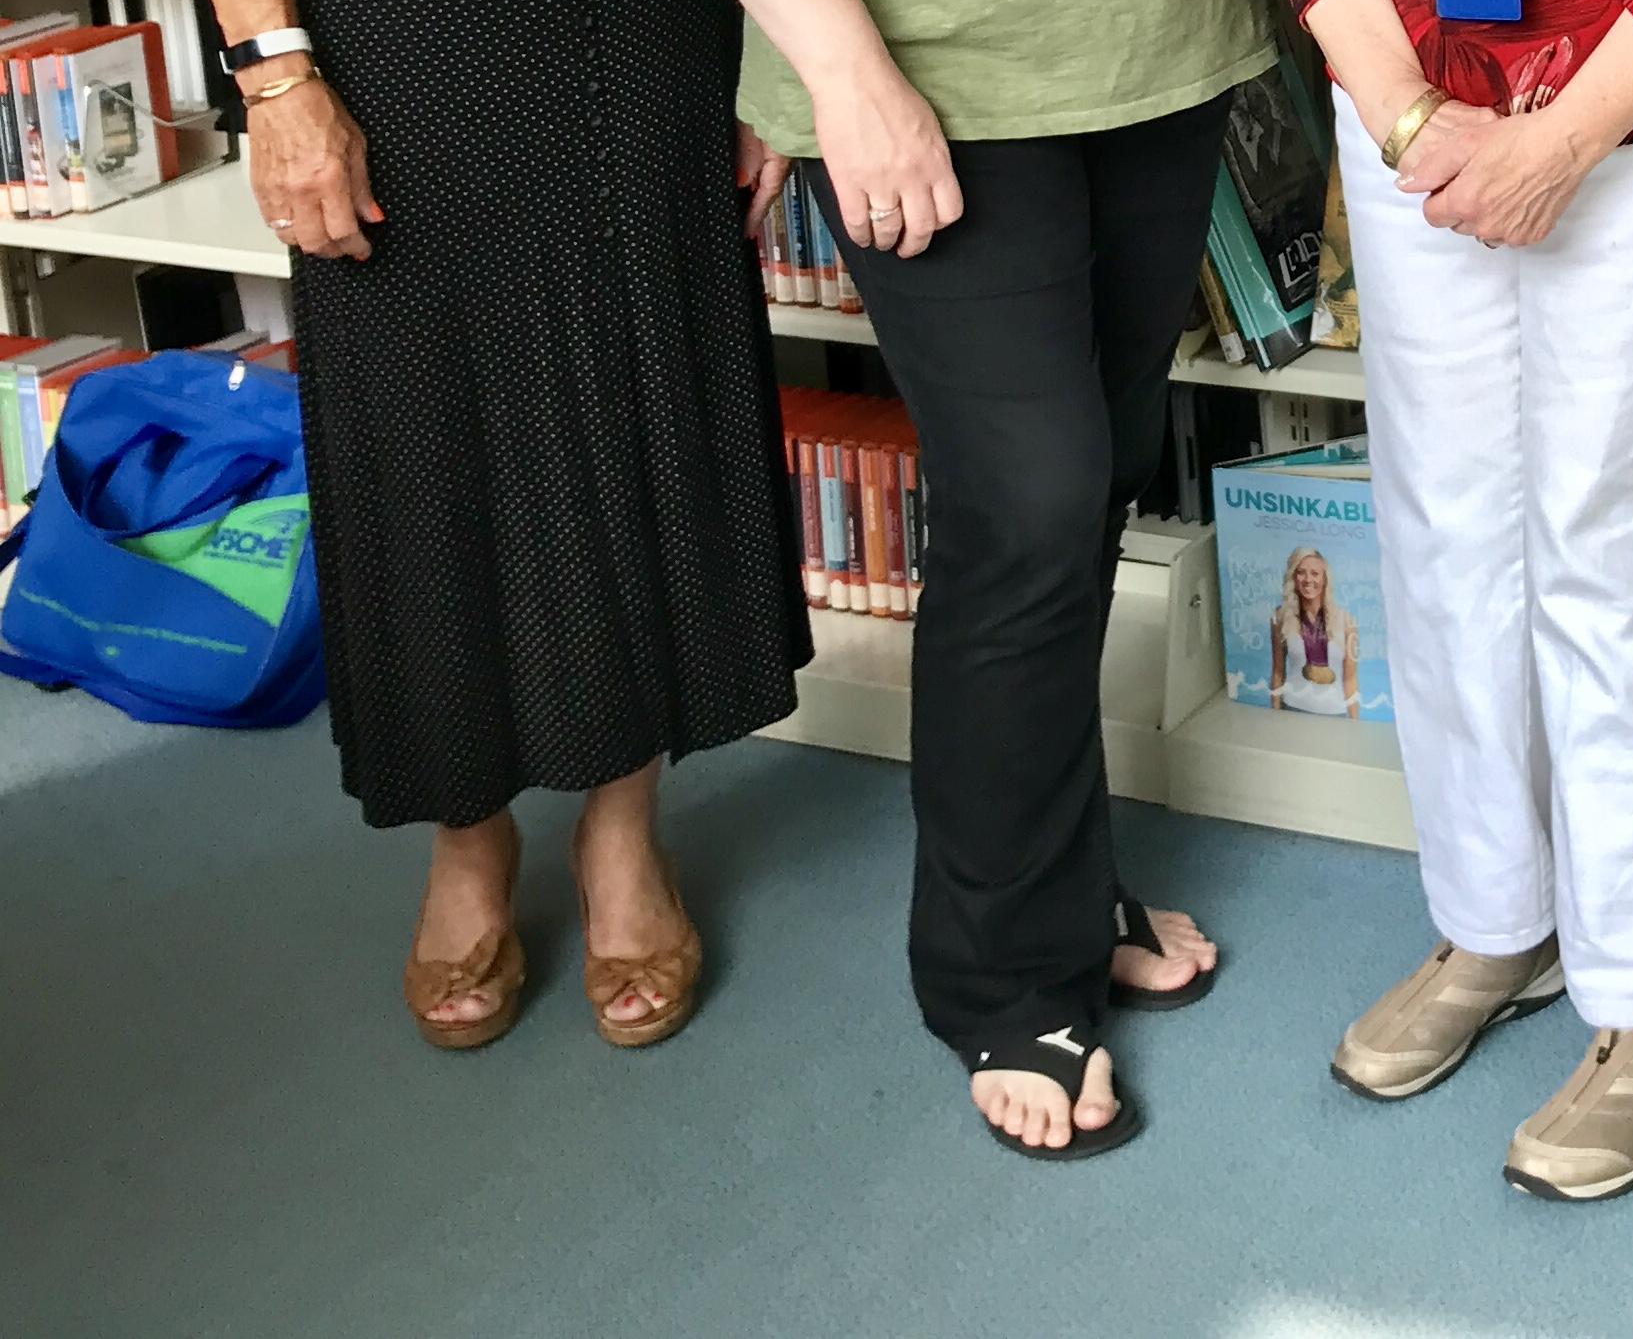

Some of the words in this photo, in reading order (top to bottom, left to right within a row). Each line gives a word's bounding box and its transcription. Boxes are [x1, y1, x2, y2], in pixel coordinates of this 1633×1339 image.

[1225, 487, 1376, 523] UNSINKABL
[1253, 515, 1317, 533] JESSICA
[1321, 523, 1366, 539] LONG
